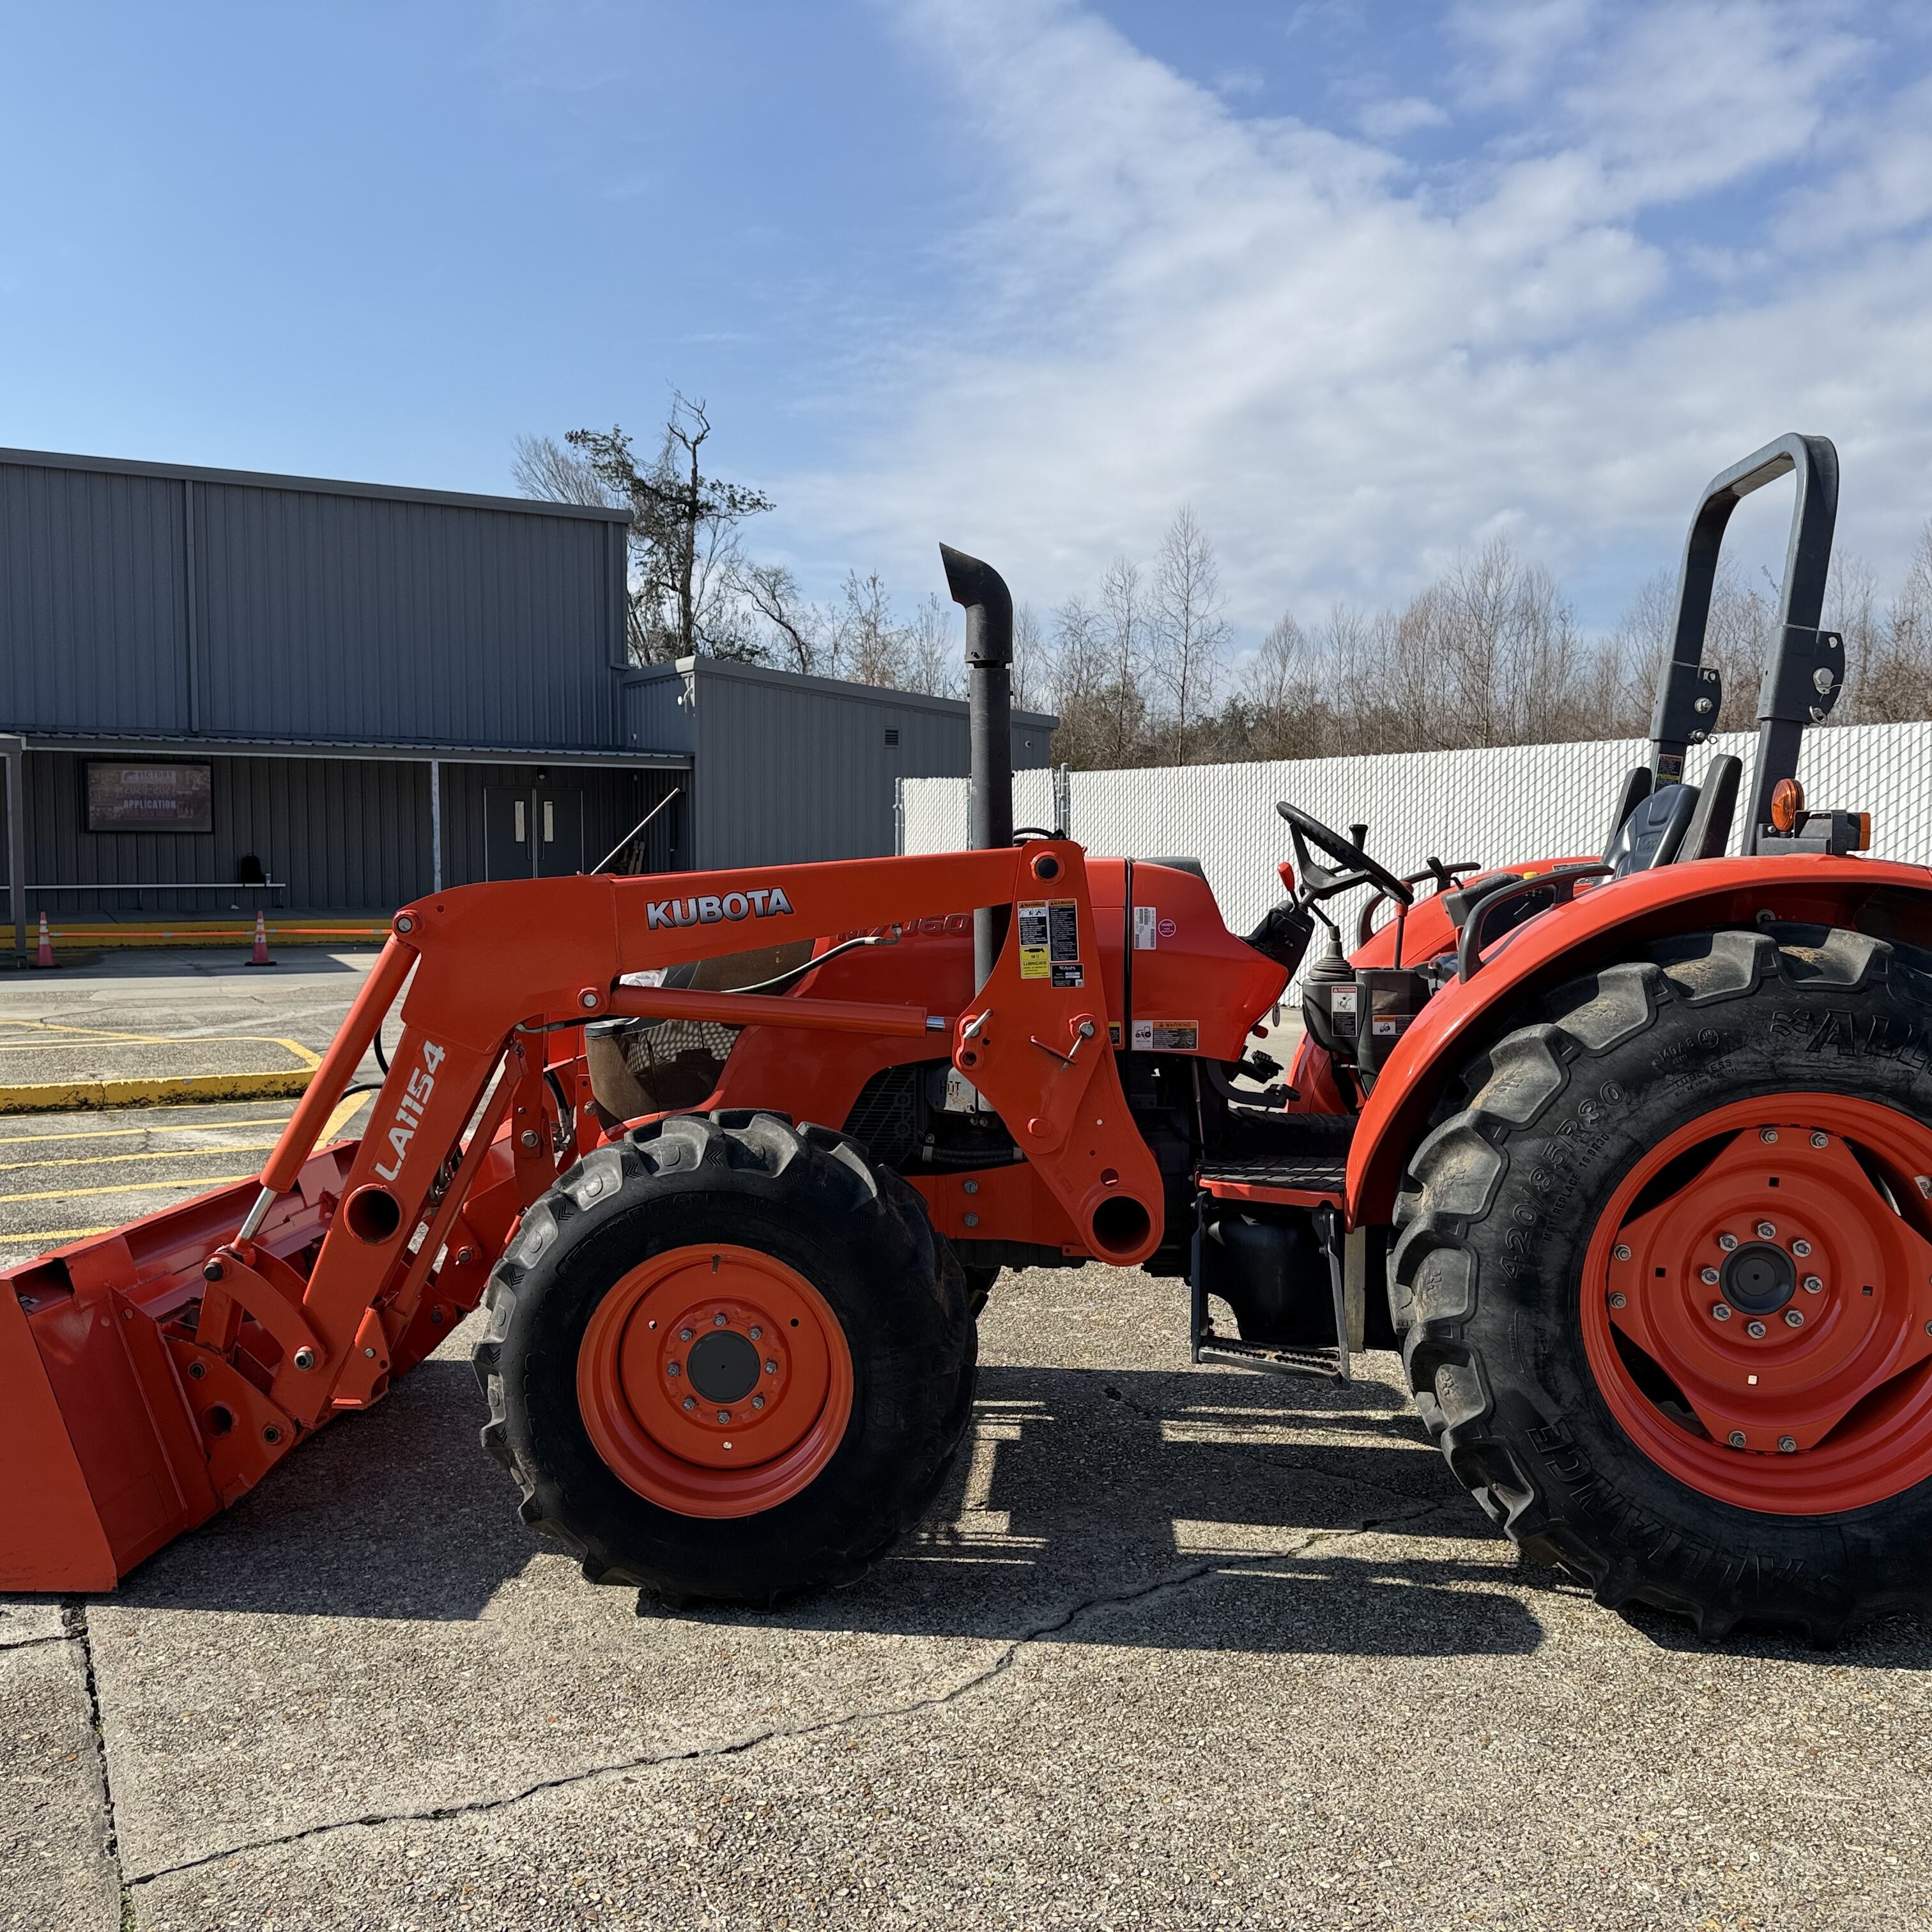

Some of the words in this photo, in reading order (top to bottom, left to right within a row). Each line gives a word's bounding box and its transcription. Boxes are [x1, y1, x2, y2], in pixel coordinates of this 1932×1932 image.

[123, 799, 176, 810] APPLICATION
[646, 886, 795, 930] KUBOTA
[1806, 1008, 1932, 1076] ALL
[374, 1039, 446, 1181] LA1154
[940, 1080, 961, 1096] HOT
[1501, 1080, 1626, 1278] 420/85R30
[1552, 1172, 1581, 1215] REPLACE
